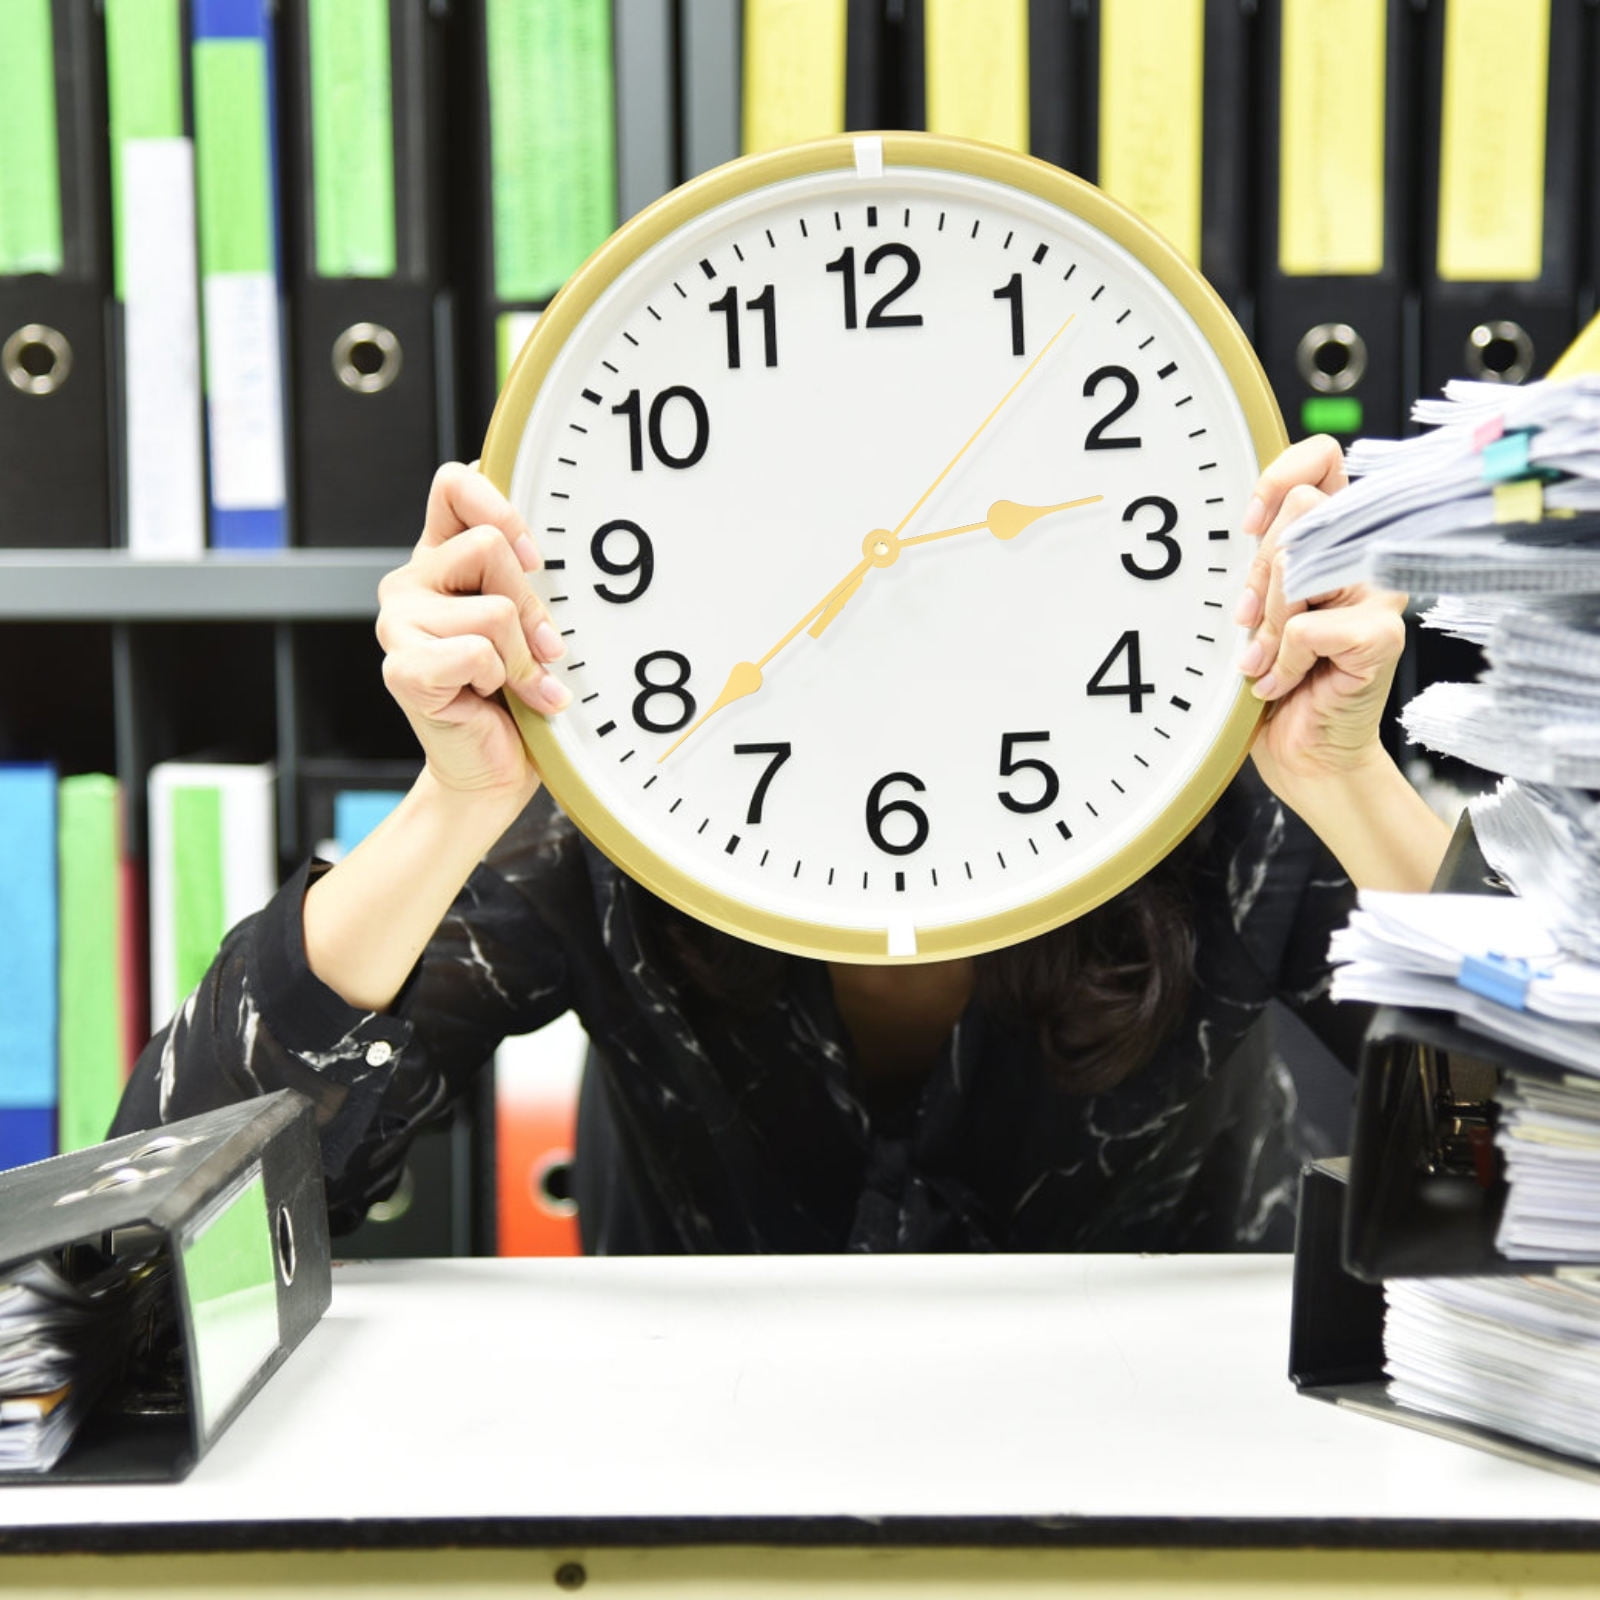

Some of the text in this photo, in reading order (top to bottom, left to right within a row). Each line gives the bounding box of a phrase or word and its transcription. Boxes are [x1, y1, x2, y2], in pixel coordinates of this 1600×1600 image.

[708, 284, 778, 369] 11
[826, 242, 924, 330] 12
[993, 273, 1025, 356] 1
[611, 385, 710, 472] 10
[1082, 365, 1142, 451] 2
[590, 519, 654, 604] 9
[1121, 496, 1182, 581] 3
[632, 650, 696, 734] 8
[1086, 630, 1155, 714] 4
[734, 742, 792, 825] 7
[865, 771, 929, 856] 6
[998, 731, 1060, 814] 5
